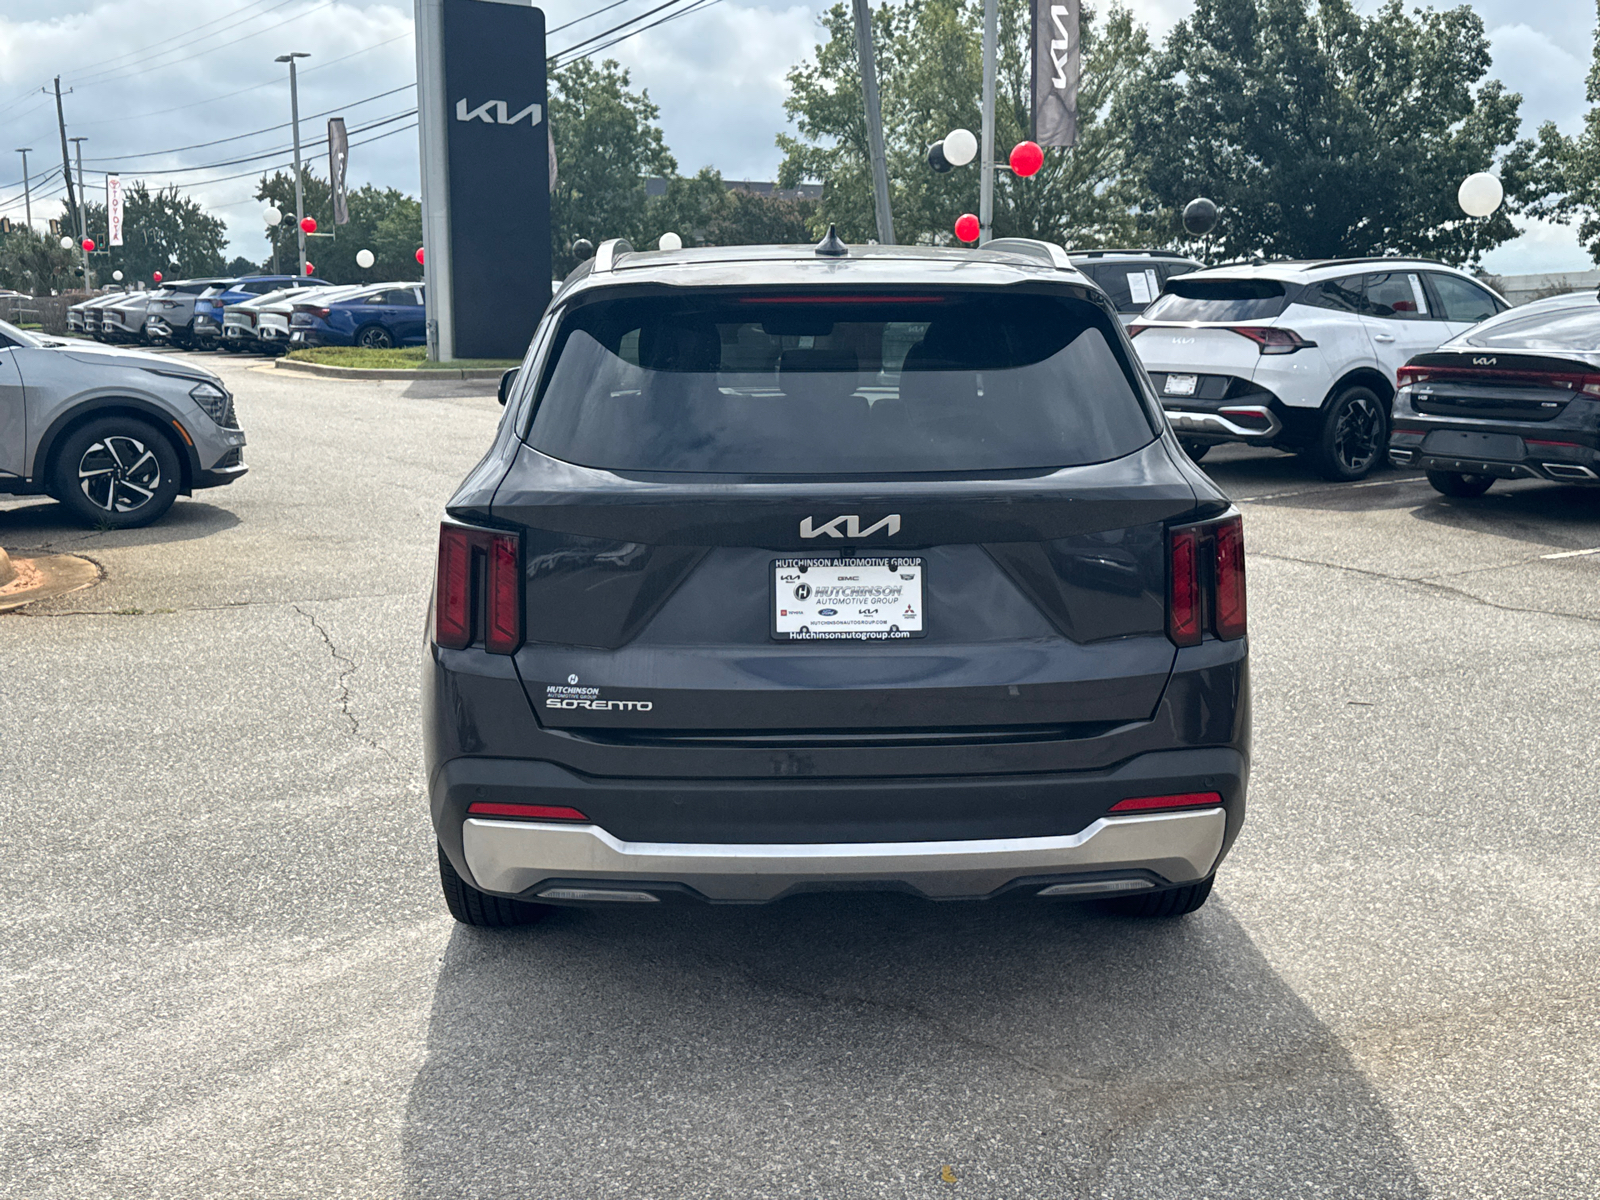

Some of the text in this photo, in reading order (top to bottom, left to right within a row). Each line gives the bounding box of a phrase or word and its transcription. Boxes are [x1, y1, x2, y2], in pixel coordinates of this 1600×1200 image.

[1050, 5, 1069, 89] KIA
[456, 97, 542, 127] KIA
[112, 190, 120, 241] TOYOTA
[1472, 357, 1497, 365] KIA
[800, 514, 901, 538] KIA
[775, 558, 921, 568] HUTCHINSON AUTOMOTIVE GROUP
[814, 585, 903, 598] HUTCHINSON
[789, 631, 910, 640] Hutchinsonautogroup.com
[546, 686, 599, 695] HUTCHINSON
[546, 698, 653, 711] SORENTO
